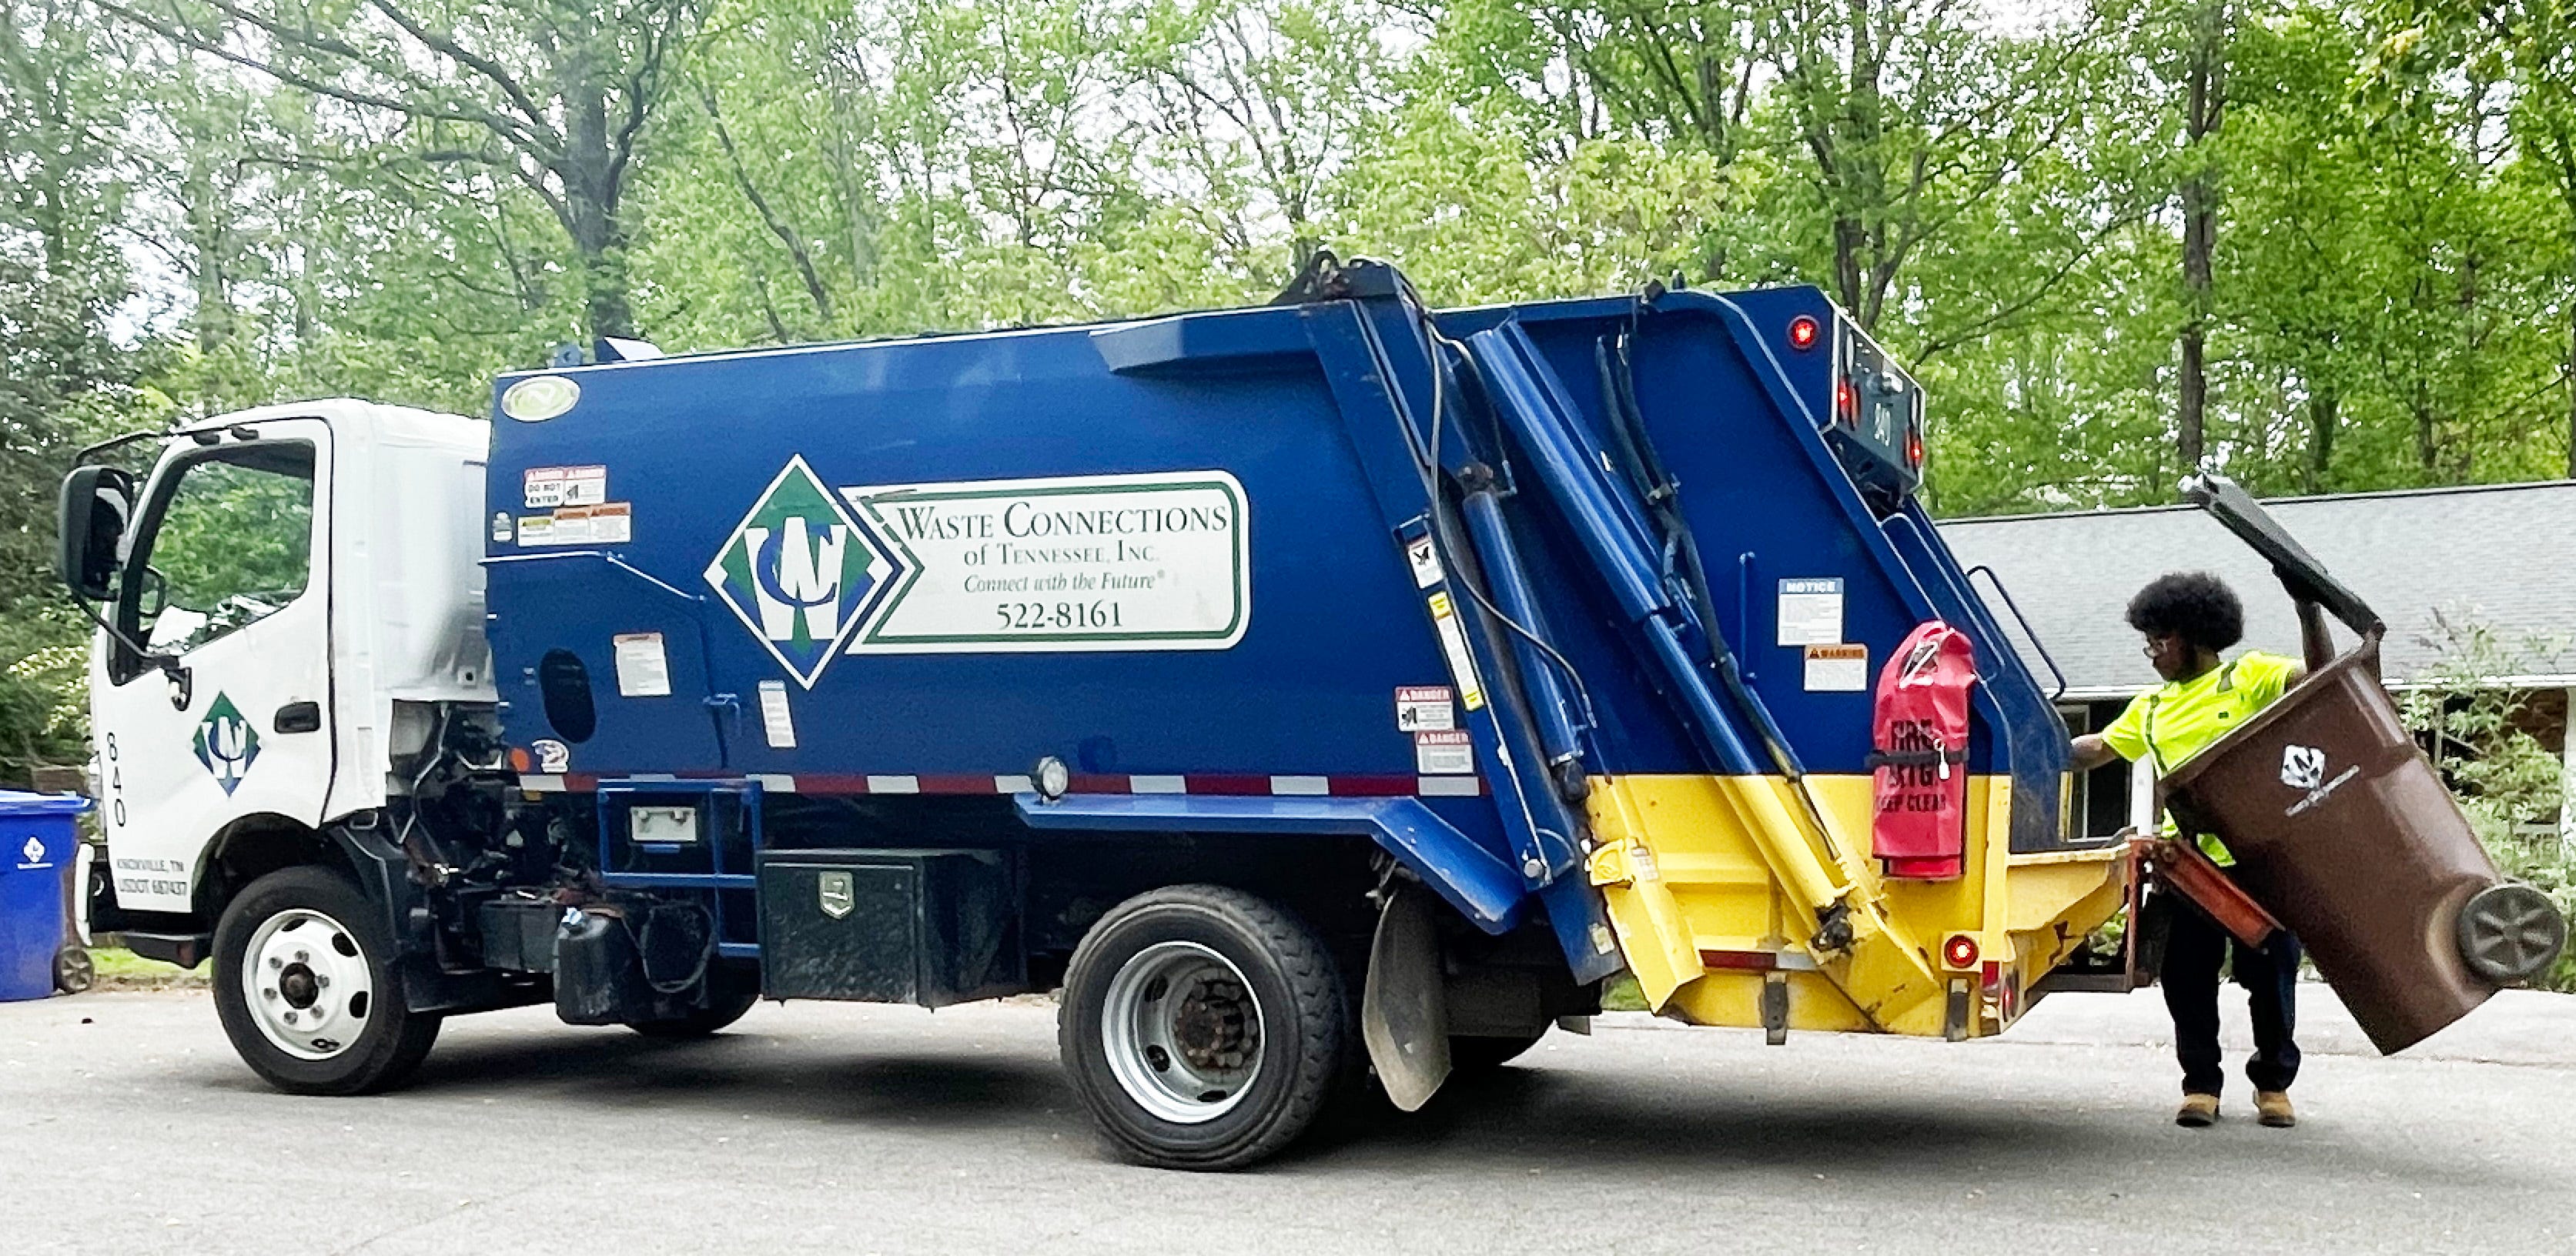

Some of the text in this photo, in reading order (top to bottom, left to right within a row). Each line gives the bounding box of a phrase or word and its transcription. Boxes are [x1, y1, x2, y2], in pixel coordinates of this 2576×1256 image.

[528, 483, 560, 493] DO NOT
[530, 495, 559, 504] ENTER
[897, 501, 1228, 540] WASTE CONNECTIONS
[964, 542, 989, 566] of
[964, 574, 1029, 593] Connect
[1033, 573, 1067, 592] with
[1072, 572, 1096, 590] the
[1786, 581, 1835, 593] NOTICE
[996, 598, 1123, 630] 522-8161
[1410, 689, 1451, 700] DANGER
[1429, 732, 1470, 744] DANGER
[1908, 793, 1946, 812] CLEAR
[170, 860, 185, 872] TN
[119, 878, 149, 894] USDOT
